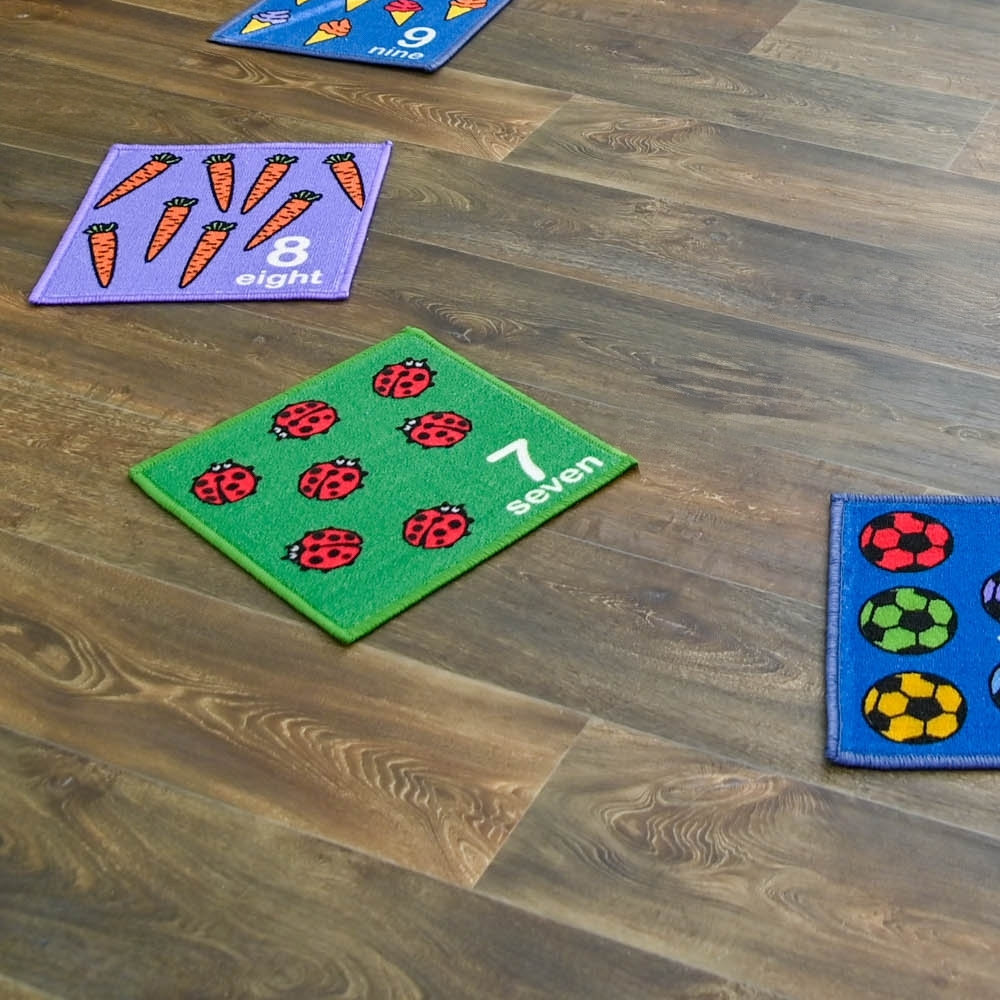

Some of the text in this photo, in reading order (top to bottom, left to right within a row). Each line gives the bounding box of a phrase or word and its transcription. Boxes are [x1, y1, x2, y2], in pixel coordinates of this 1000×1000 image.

[397, 26, 437, 48] 9
[367, 46, 425, 60] nine
[266, 235, 311, 267] 8
[235, 269, 324, 289] eight
[486, 438, 546, 482] 7
[505, 455, 604, 515] seven
